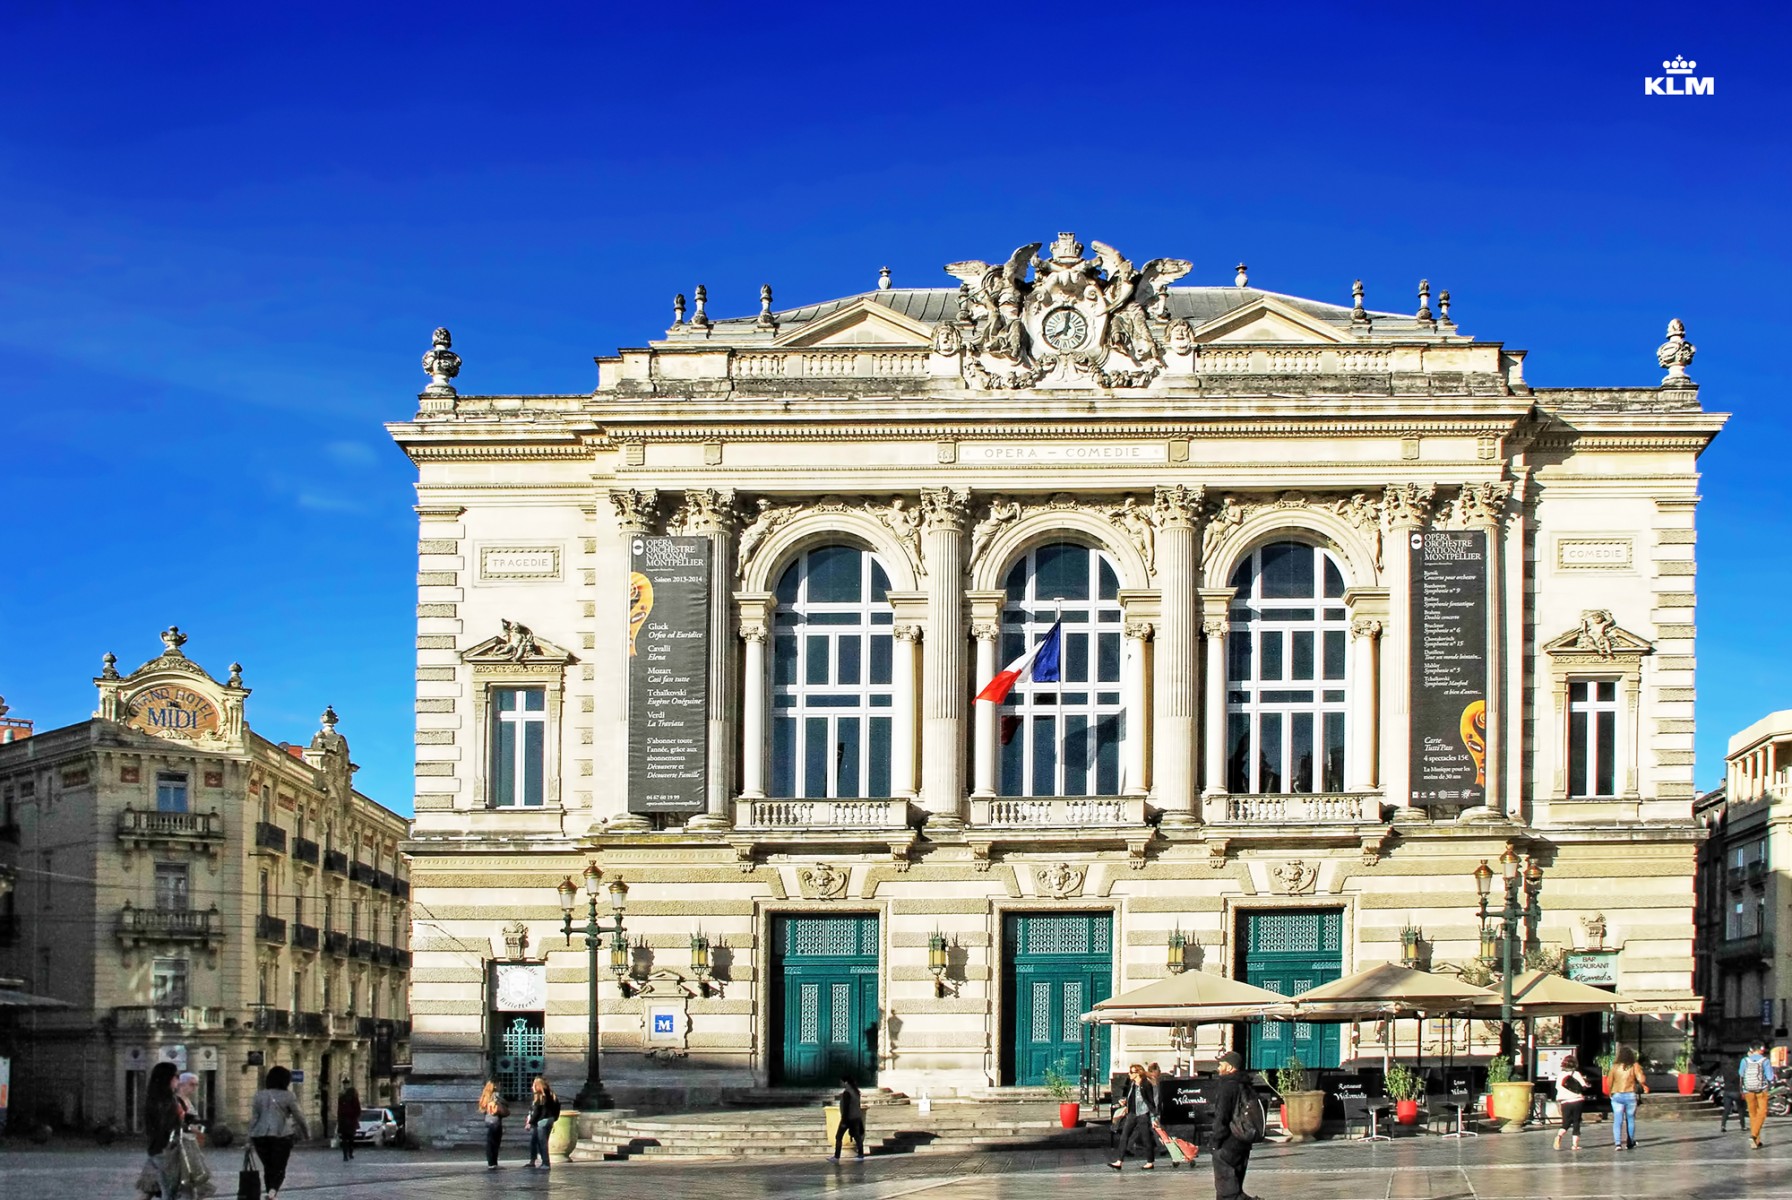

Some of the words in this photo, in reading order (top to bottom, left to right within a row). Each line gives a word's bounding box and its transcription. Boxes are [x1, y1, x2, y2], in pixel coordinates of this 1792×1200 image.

[984, 448, 1038, 458] OPERA
[1065, 447, 1140, 457] COMEDIE
[1569, 550, 1622, 558] COMEDIE
[492, 558, 548, 567] TRAGEDIE
[661, 675, 674, 684] fan
[129, 687, 170, 717] GRAND
[147, 707, 197, 729] MIDI
[658, 719, 684, 727] Traviata
[1429, 755, 1457, 763] spectacles
[658, 1019, 671, 1030] M
